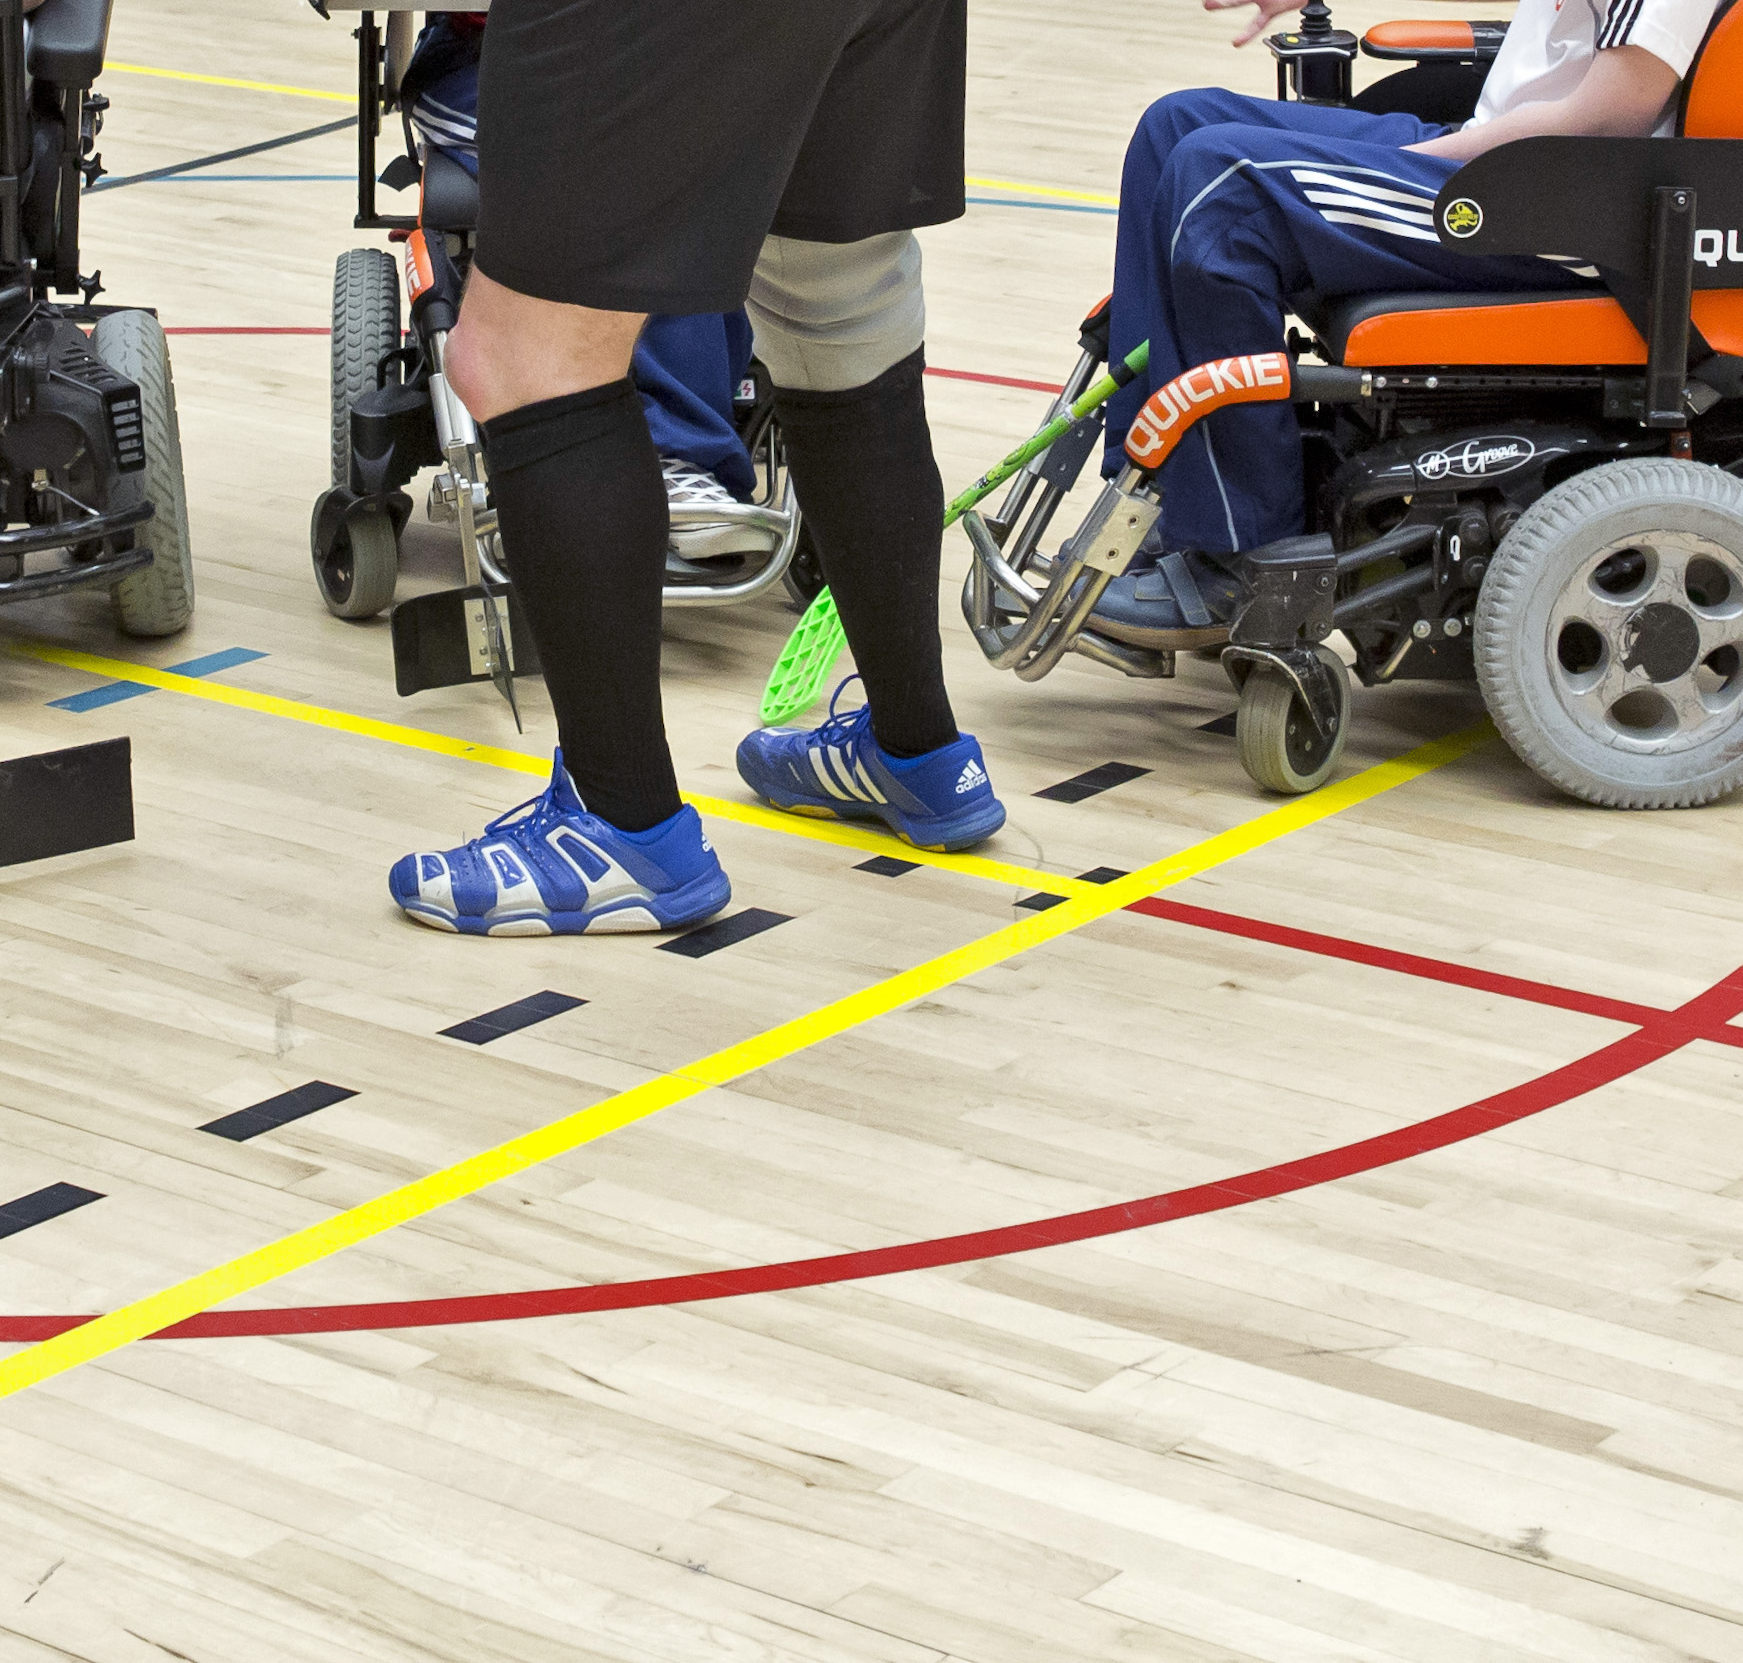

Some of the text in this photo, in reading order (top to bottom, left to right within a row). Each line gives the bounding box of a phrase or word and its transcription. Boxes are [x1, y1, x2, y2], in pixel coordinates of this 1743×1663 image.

[1126, 353, 1284, 457] QUICKIE
[1462, 440, 1519, 474] Groove
[955, 772, 988, 794] adidas
